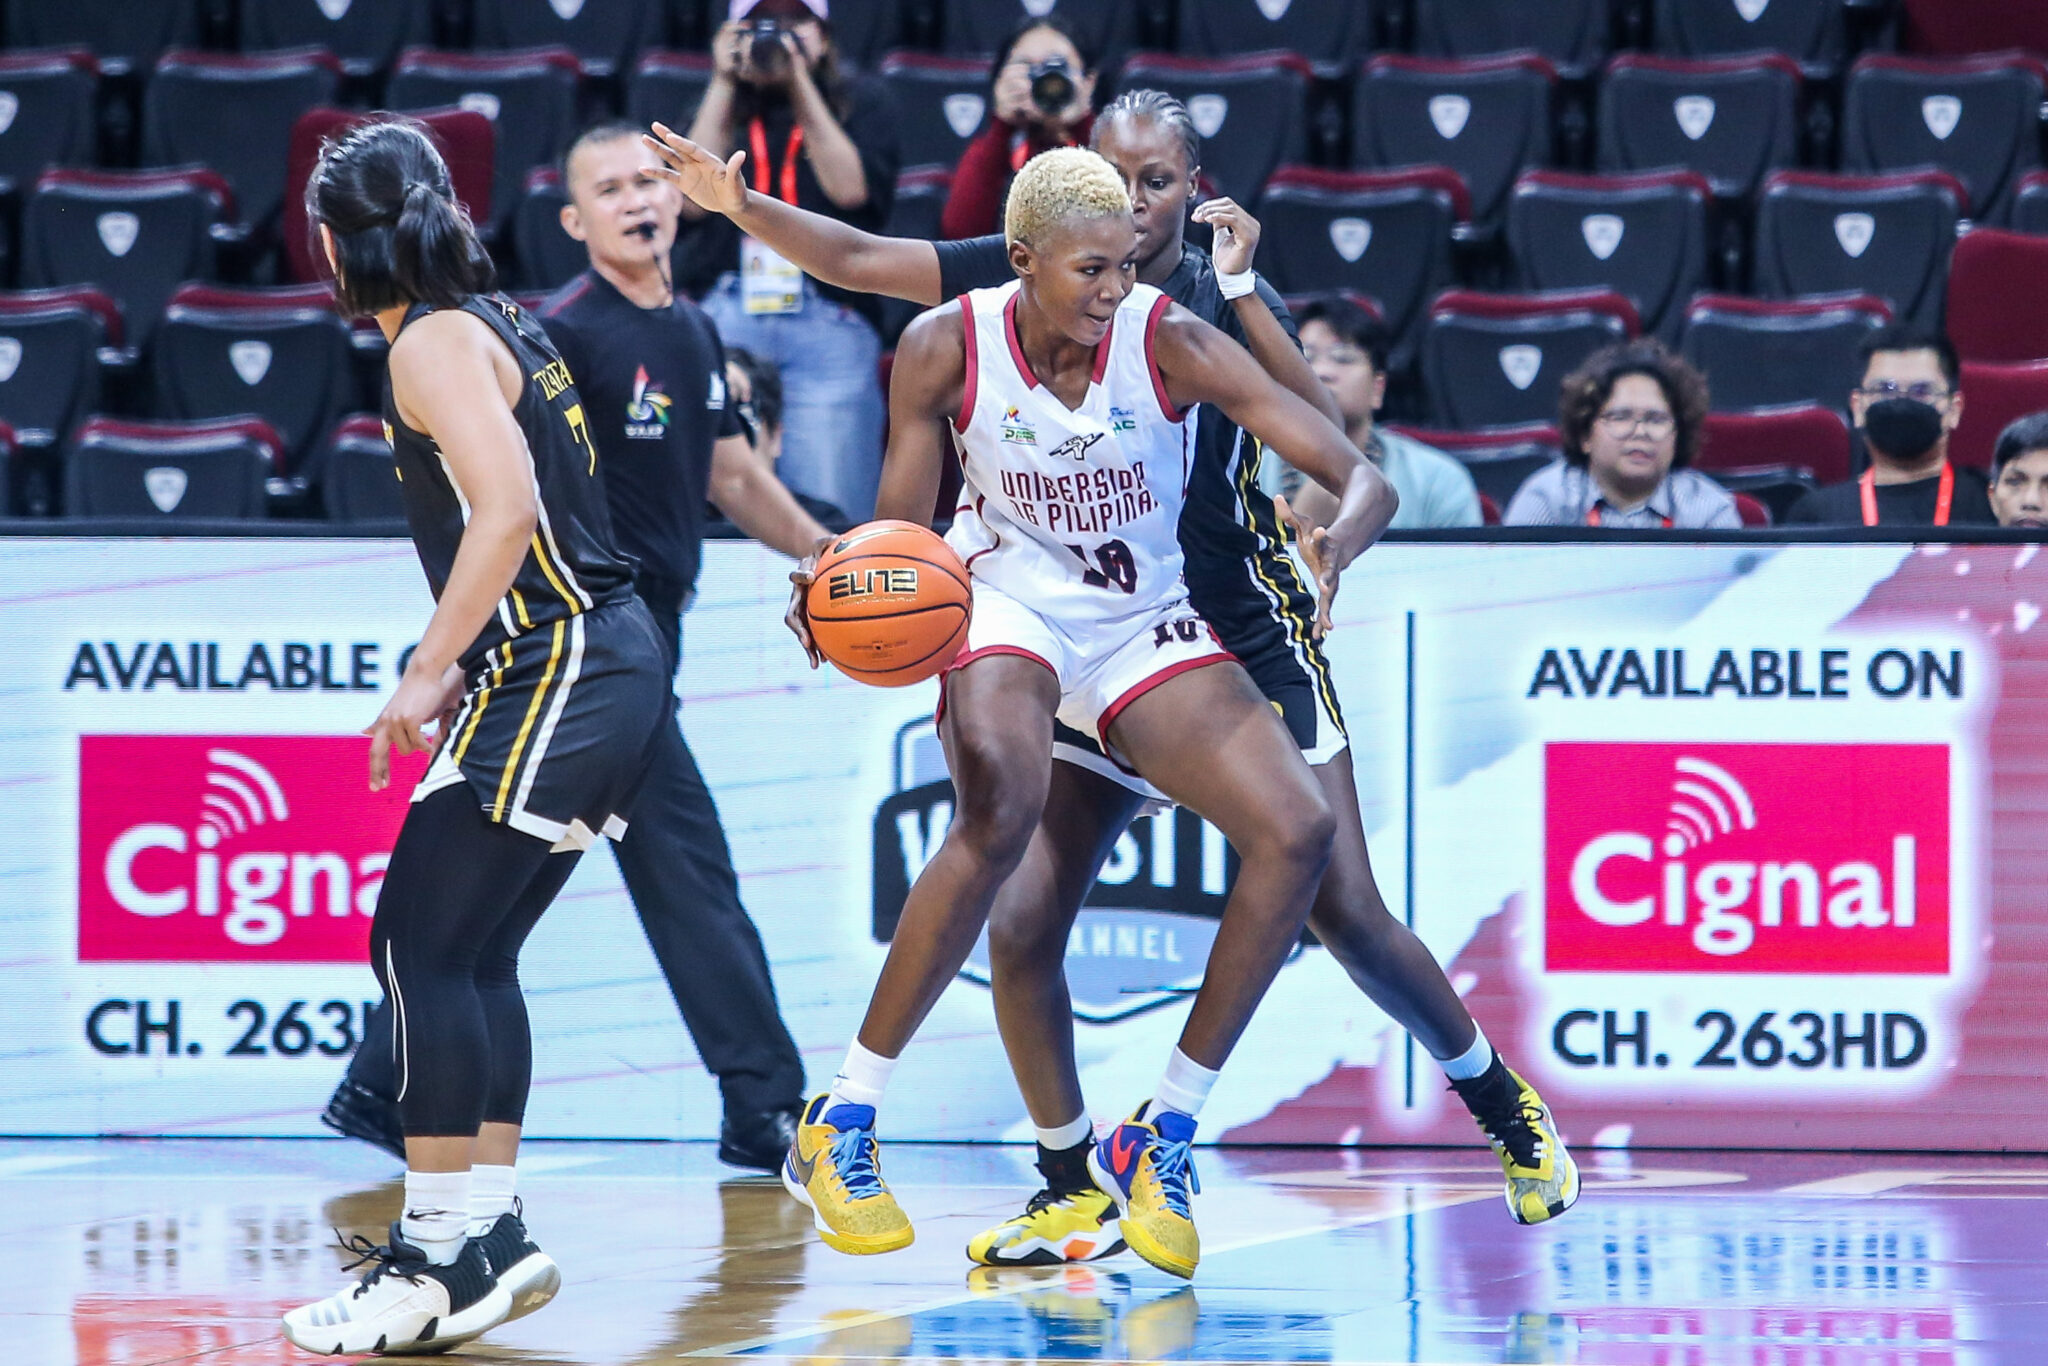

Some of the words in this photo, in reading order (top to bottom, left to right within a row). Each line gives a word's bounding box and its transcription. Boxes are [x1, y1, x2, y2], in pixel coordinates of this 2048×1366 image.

[563, 403, 596, 477] 7
[1000, 461, 1145, 504] UNIBERSIDA
[1047, 490, 1158, 532] PILIPINA
[829, 568, 918, 601] ELITE
[1063, 538, 1138, 595] 10
[65, 642, 380, 689] AVAILABLE
[1527, 648, 1849, 699] AVAILABLE
[1867, 648, 1964, 700] ON
[104, 822, 392, 946] Cigna
[1570, 831, 1917, 956] Cignal
[1066, 924, 1183, 962] ANNEL
[85, 998, 202, 1056] CH.
[226, 998, 371, 1056] 263
[1552, 1009, 1670, 1067] CH.
[1694, 1010, 1928, 1069] 263HD
